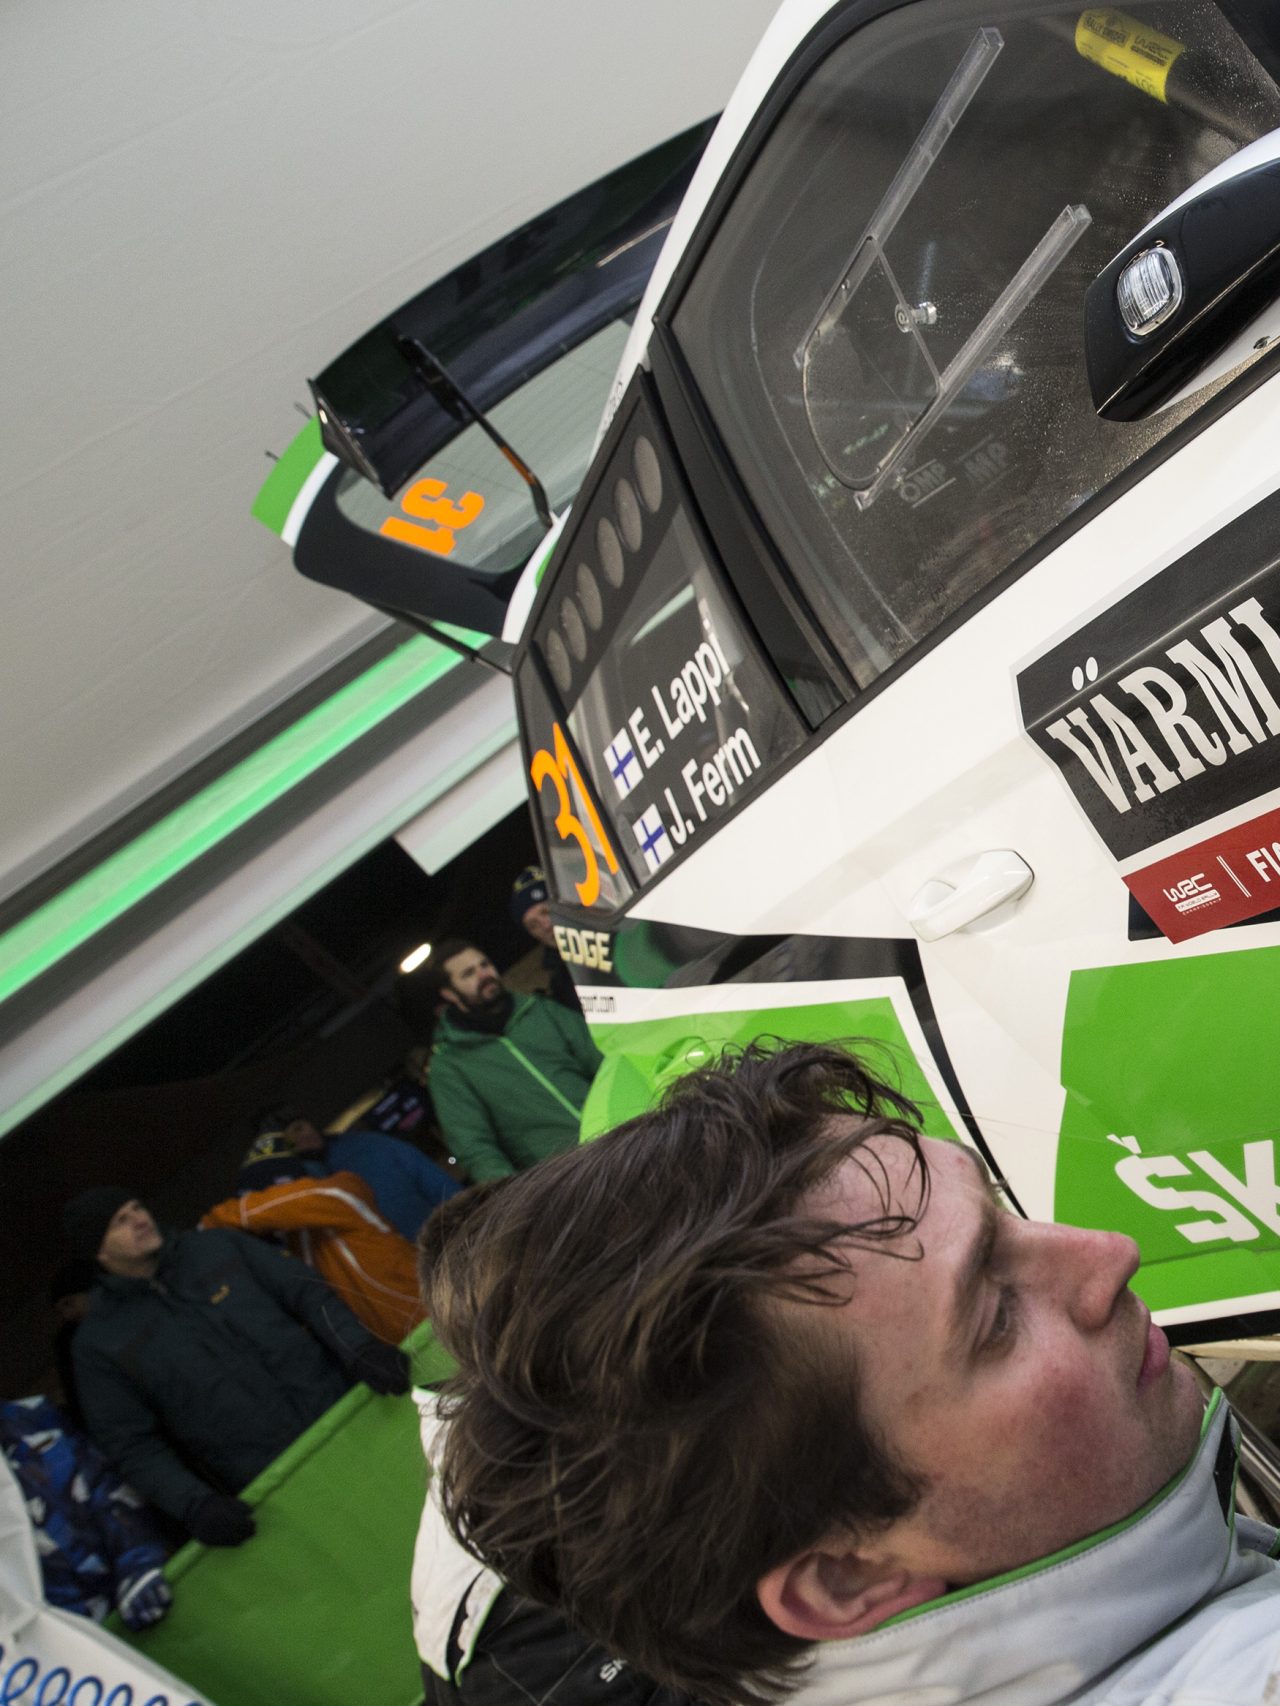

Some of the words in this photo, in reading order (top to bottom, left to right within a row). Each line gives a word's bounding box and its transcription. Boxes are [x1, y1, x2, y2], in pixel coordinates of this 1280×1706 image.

[379, 477, 485, 557] 31
[628, 706, 665, 769] E.
[651, 618, 730, 723] Lappi
[530, 721, 619, 907] 31
[664, 787, 695, 845] J.
[681, 727, 761, 822] Ferm
[1162, 872, 1213, 902] WRC
[553, 925, 613, 973] EDGE
